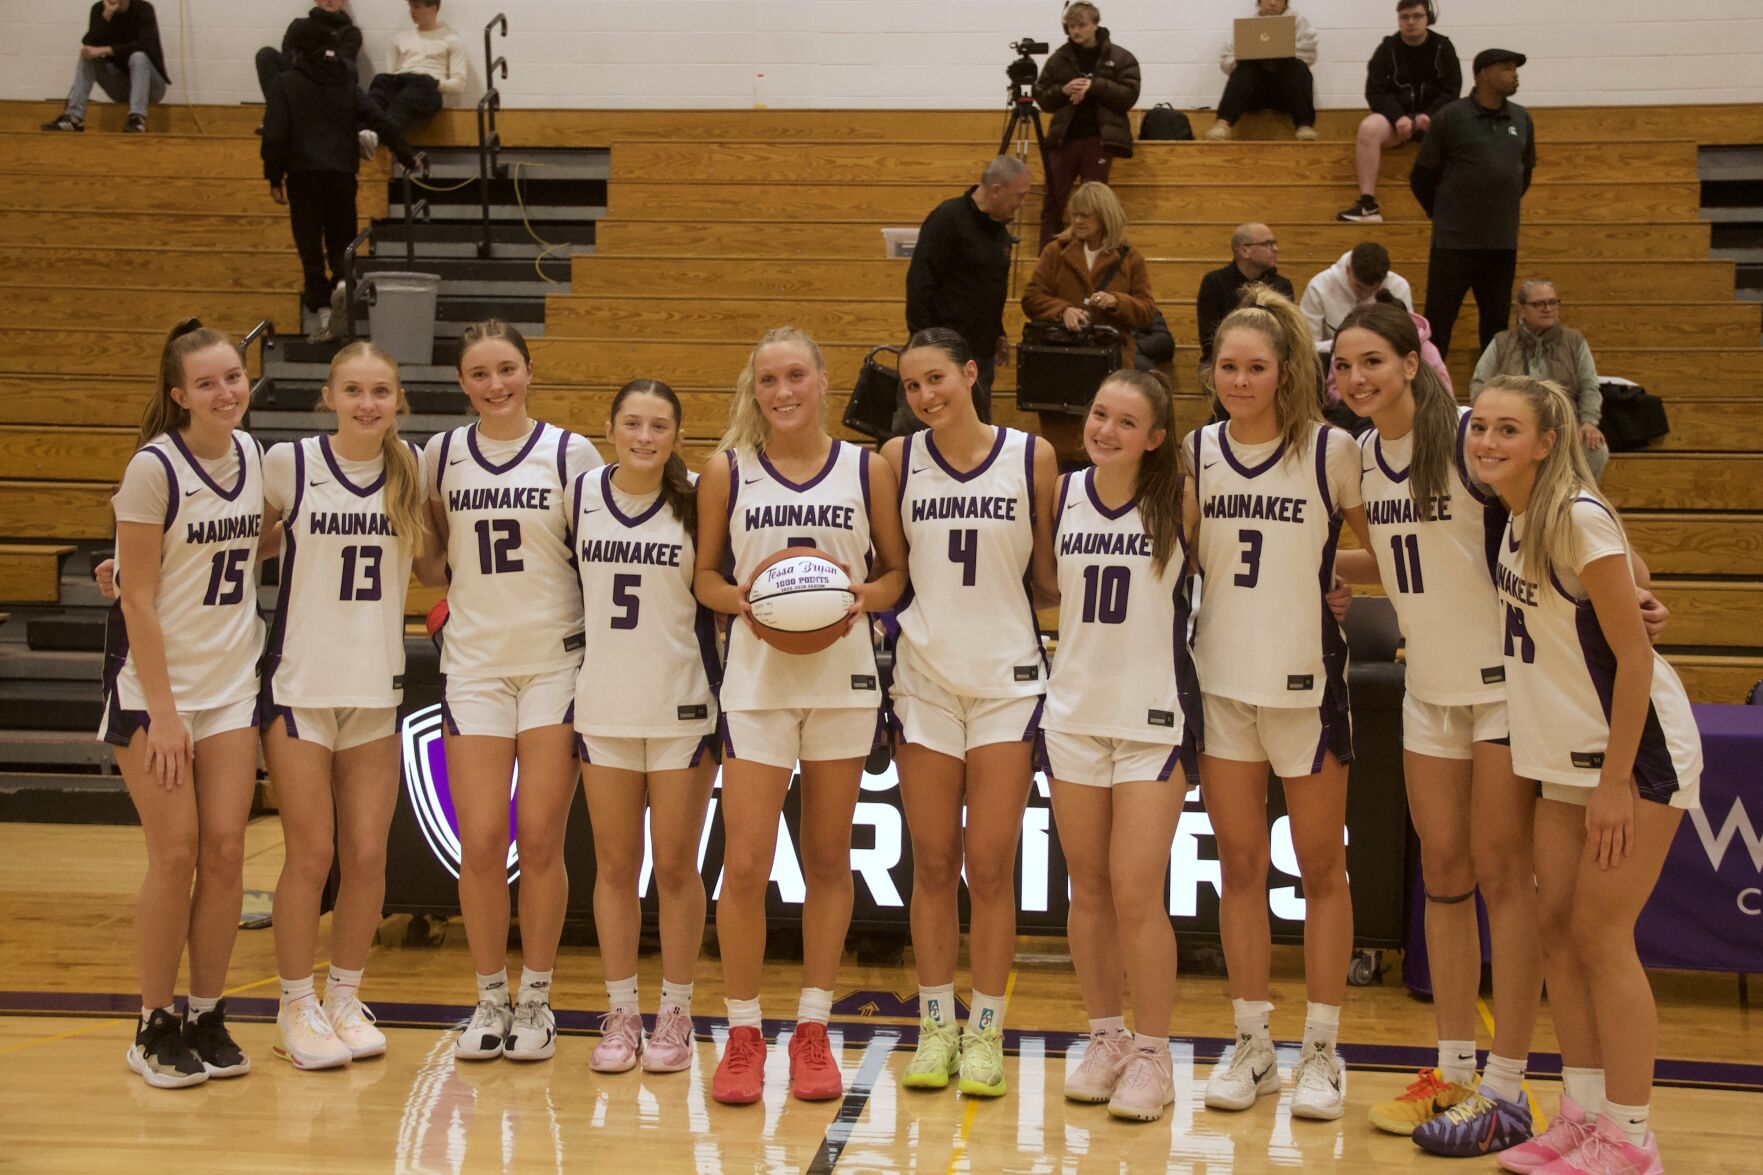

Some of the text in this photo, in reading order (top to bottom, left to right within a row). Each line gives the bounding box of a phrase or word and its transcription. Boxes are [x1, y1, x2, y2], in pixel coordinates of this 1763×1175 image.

[448, 487, 552, 512] WAUNAKEE
[912, 496, 1018, 523] WAUNAKEE
[1203, 494, 1307, 524] WAUNAKEE
[186, 513, 262, 545] WAUNAKE
[310, 512, 399, 537] WAUNAK
[745, 504, 855, 532] WAUNAKEE
[474, 518, 525, 575] 12
[581, 539, 683, 568] WAUNAKEE
[948, 529, 978, 587] 4
[1060, 531, 1160, 558] WAUNAKE
[1233, 529, 1263, 589] 3
[202, 548, 251, 606] 15
[339, 545, 383, 602] 13
[767, 560, 838, 582] Tessa Bryan
[1390, 533, 1425, 594] 11
[776, 576, 829, 588] 1000 POINTS
[1081, 564, 1131, 625] 10
[610, 573, 642, 630] 5
